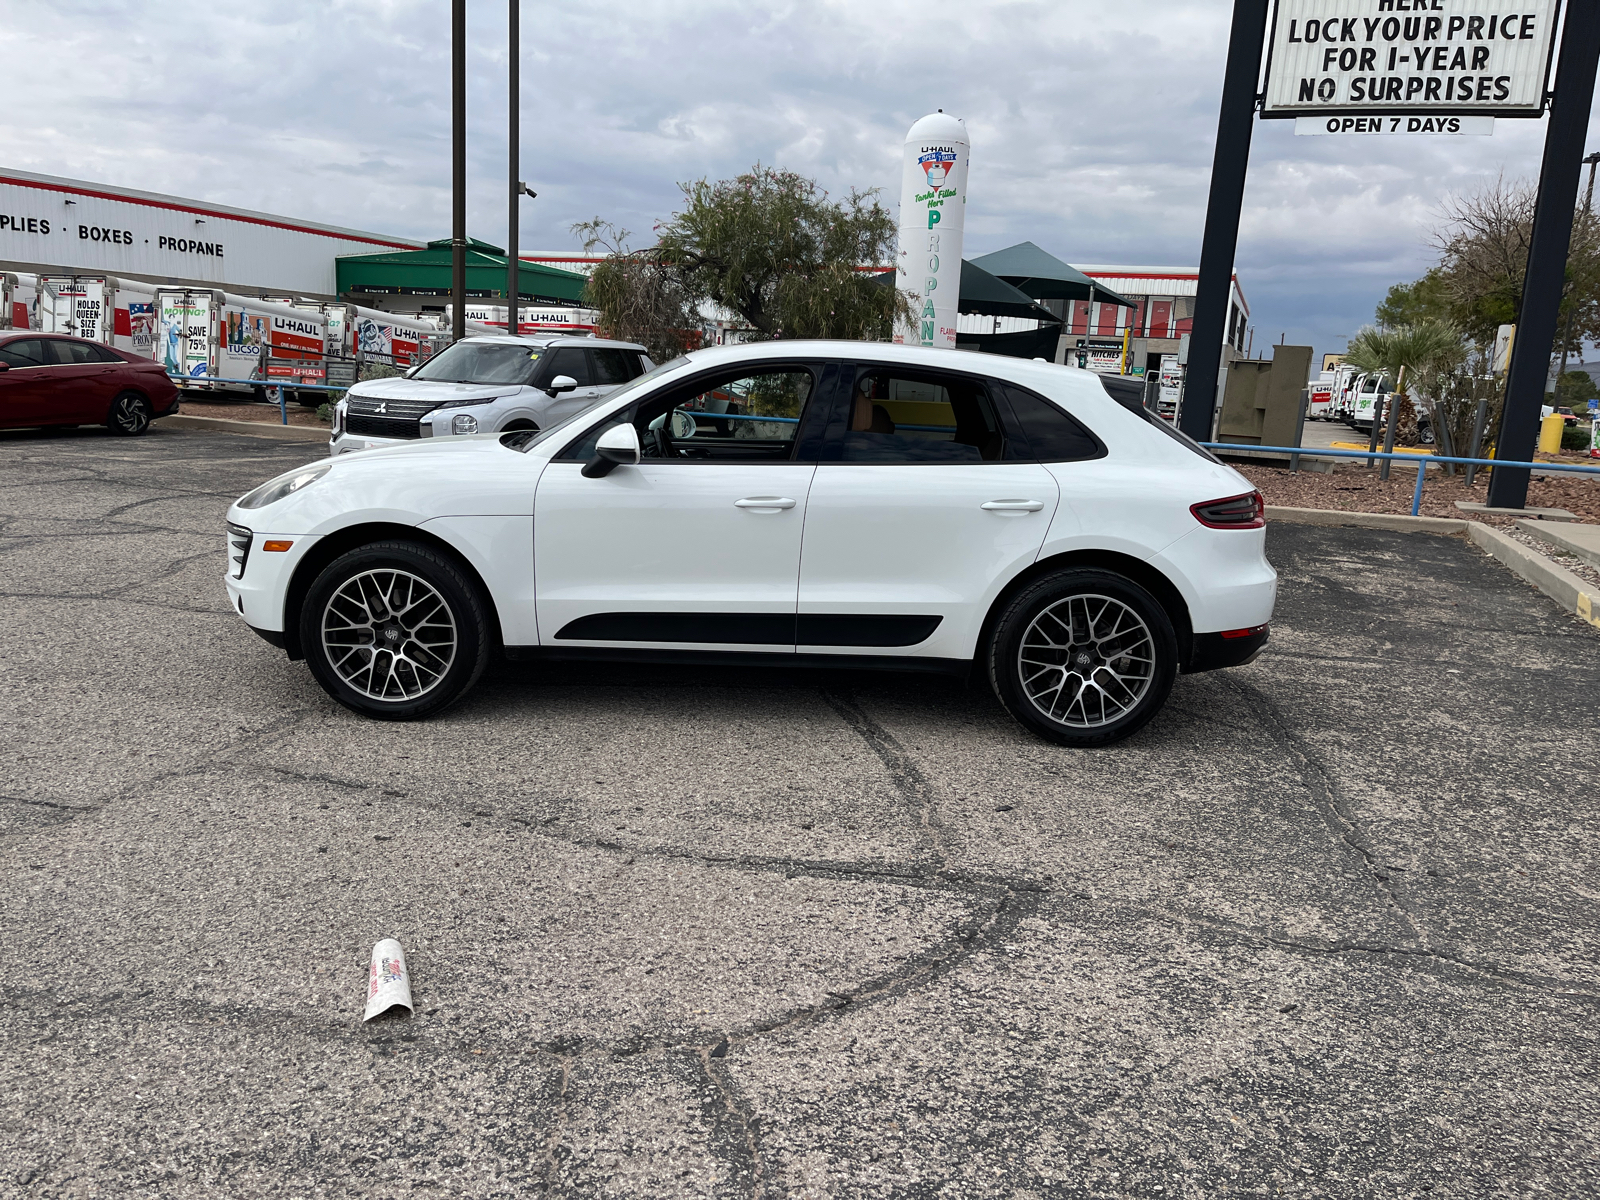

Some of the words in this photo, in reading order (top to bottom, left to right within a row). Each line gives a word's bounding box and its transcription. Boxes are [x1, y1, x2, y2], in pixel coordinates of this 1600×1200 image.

[1289, 17, 1357, 43] LOCK
[1363, 16, 1442, 41] YOUR
[1448, 14, 1536, 40] PRICE
[1322, 47, 1377, 72] FOR
[1298, 77, 1336, 102] NO
[1350, 76, 1511, 101] SURPRISES
[1326, 117, 1383, 133] OPEN
[1389, 117, 1401, 132] 7
[1407, 117, 1461, 132] DAYS
[922, 153, 936, 161] OPEN
[915, 191, 935, 202] Tanks
[938, 188, 957, 199] Filled
[927, 199, 944, 208] Here
[78, 224, 133, 245] BOXES
[158, 235, 224, 257] PROPANE
[921, 209, 942, 346] PROPAN
[77, 300, 101, 309] HOLDS
[76, 309, 102, 319] QUEEN-
[164, 308, 206, 317] MOVNG?
[530, 313, 569, 322] U-HAUL
[80, 320, 96, 328] SIZE
[275, 317, 319, 336] U-HAUL
[81, 329, 95, 338] BED
[187, 326, 207, 336] SAVE
[188, 339, 206, 351] 75%
[327, 348, 341, 356] AVE
[1091, 351, 1120, 359] HITCHES
[293, 368, 323, 376] U-HAUL
